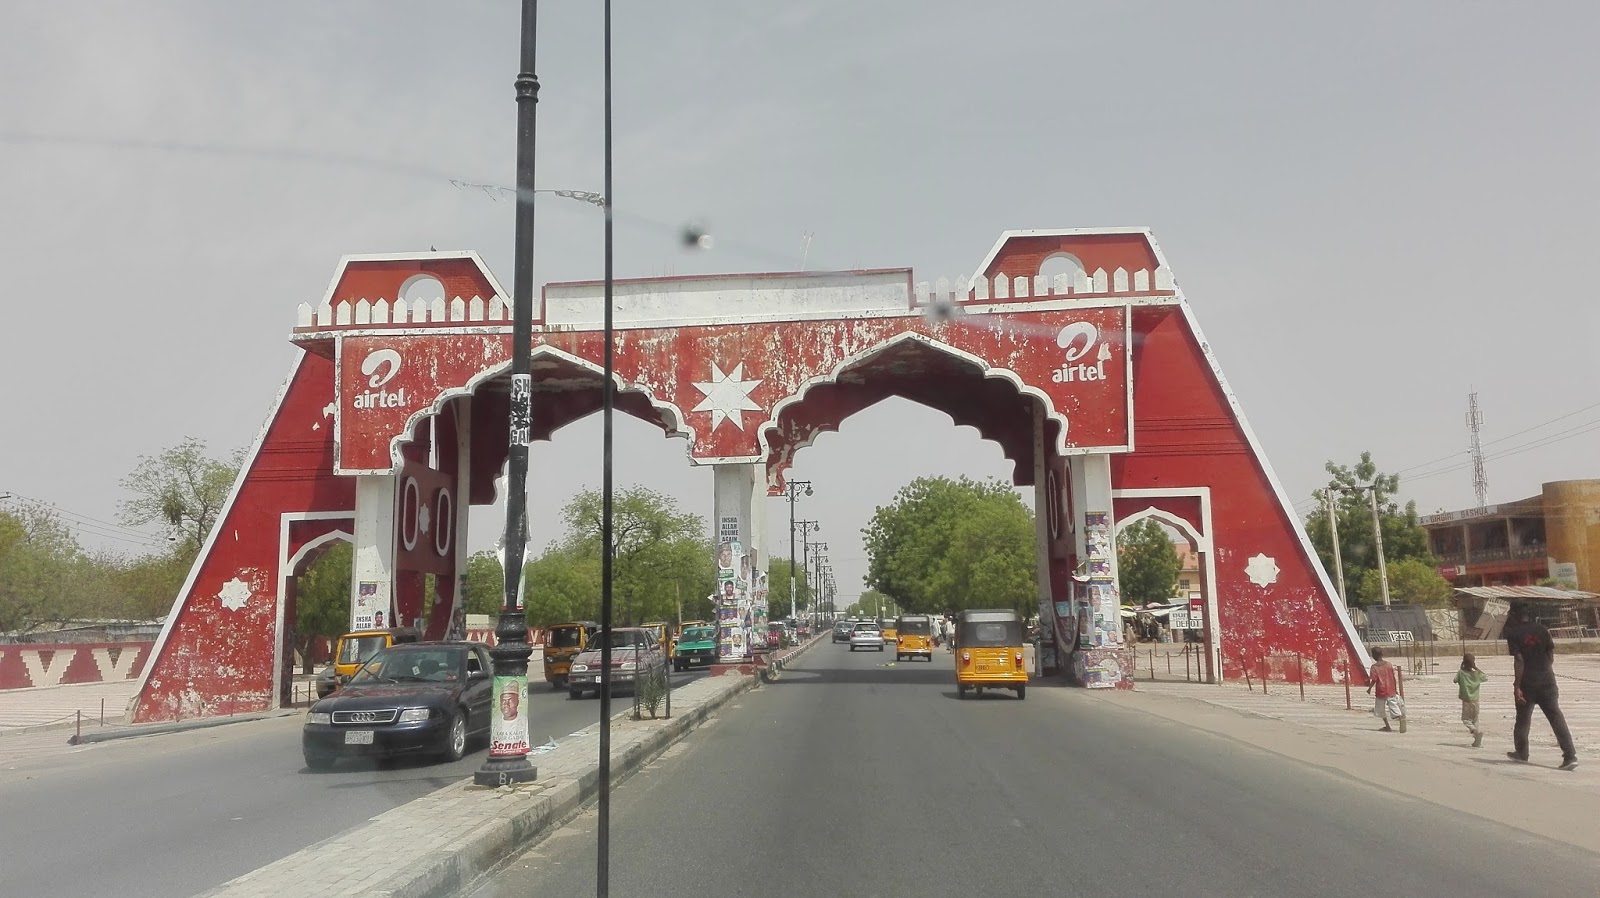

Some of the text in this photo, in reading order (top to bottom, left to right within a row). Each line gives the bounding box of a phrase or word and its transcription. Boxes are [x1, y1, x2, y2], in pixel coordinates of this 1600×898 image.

[1052, 361, 1106, 383] airtel
[353, 388, 405, 409] airtel
[1460, 506, 1489, 519] GASHUA
[492, 740, 527, 750] Senate
